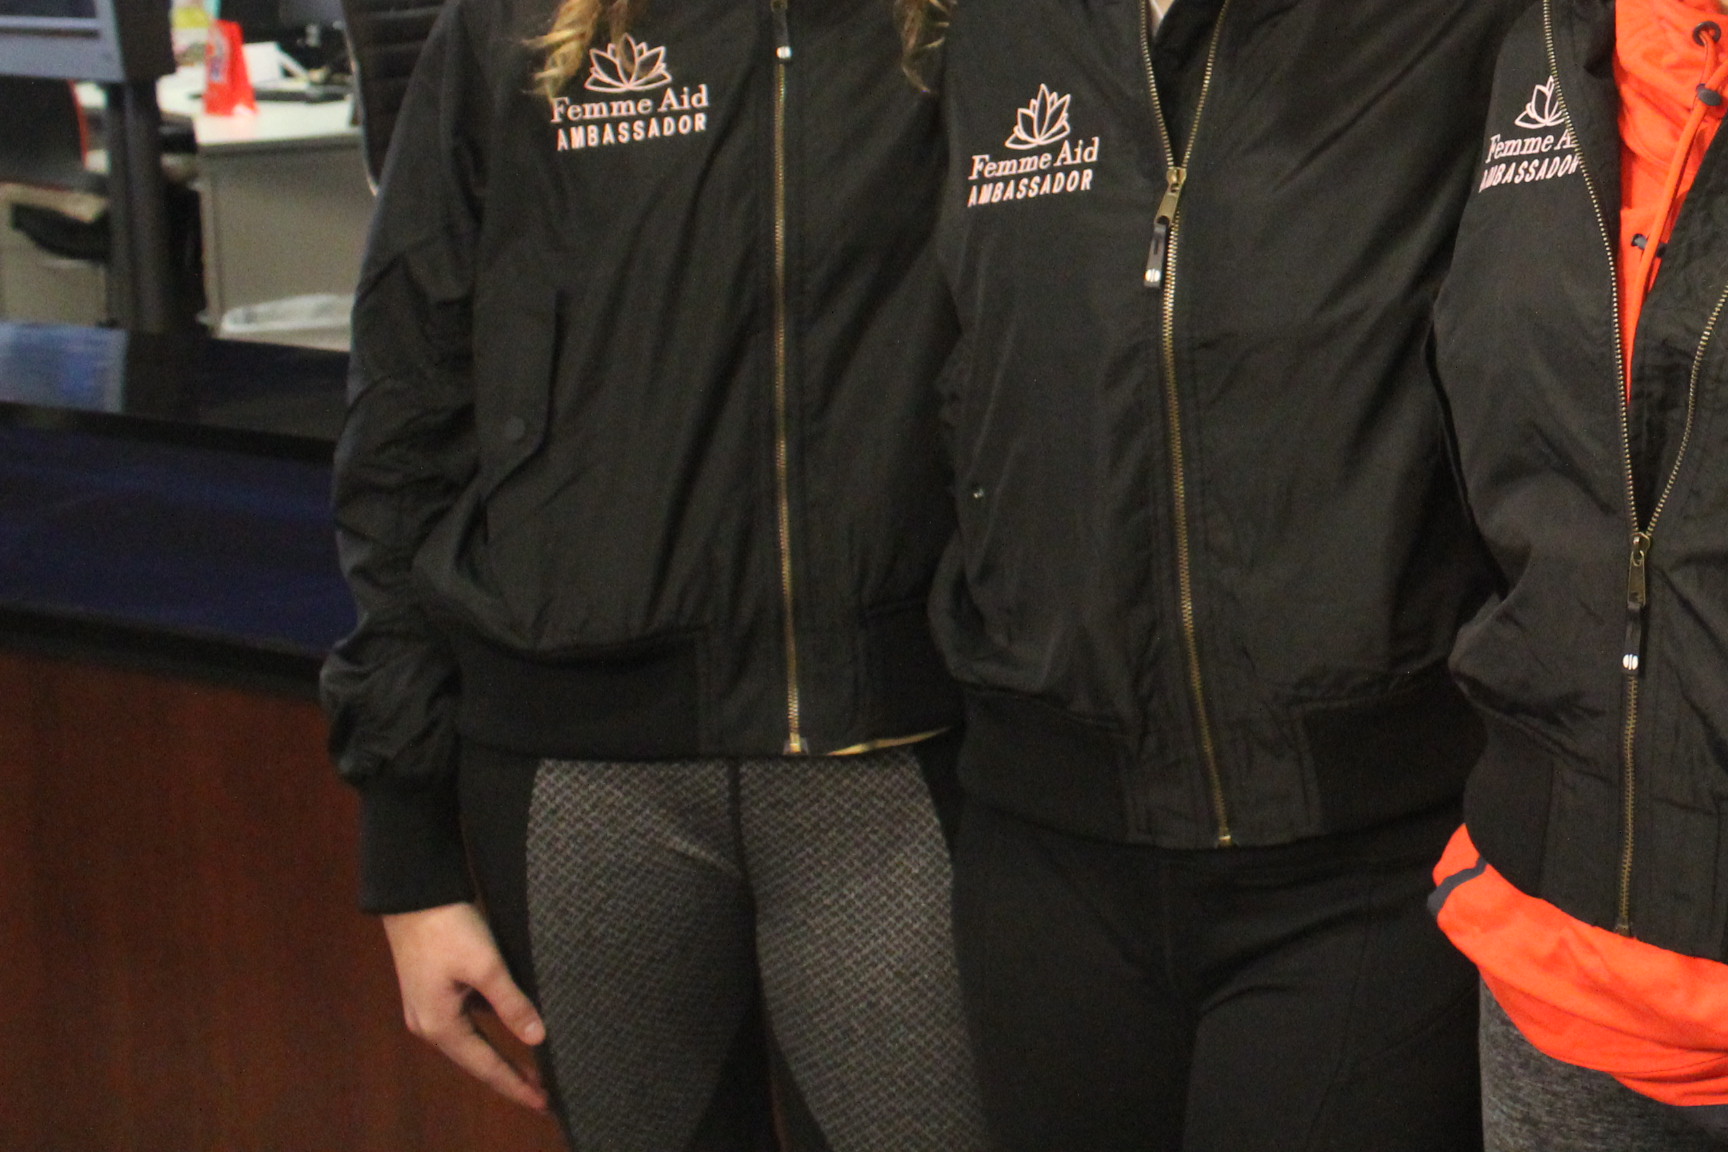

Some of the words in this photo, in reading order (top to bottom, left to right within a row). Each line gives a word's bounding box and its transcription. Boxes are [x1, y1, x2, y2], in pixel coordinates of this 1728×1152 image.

[551, 96, 653, 123] Femme
[657, 83, 710, 113] Aid
[556, 113, 707, 152] AMBASSADOR
[1485, 133, 1555, 164] Femme
[968, 152, 1052, 181] Femme
[1053, 136, 1100, 167] Aid
[967, 168, 1093, 208] AMBASSADOR
